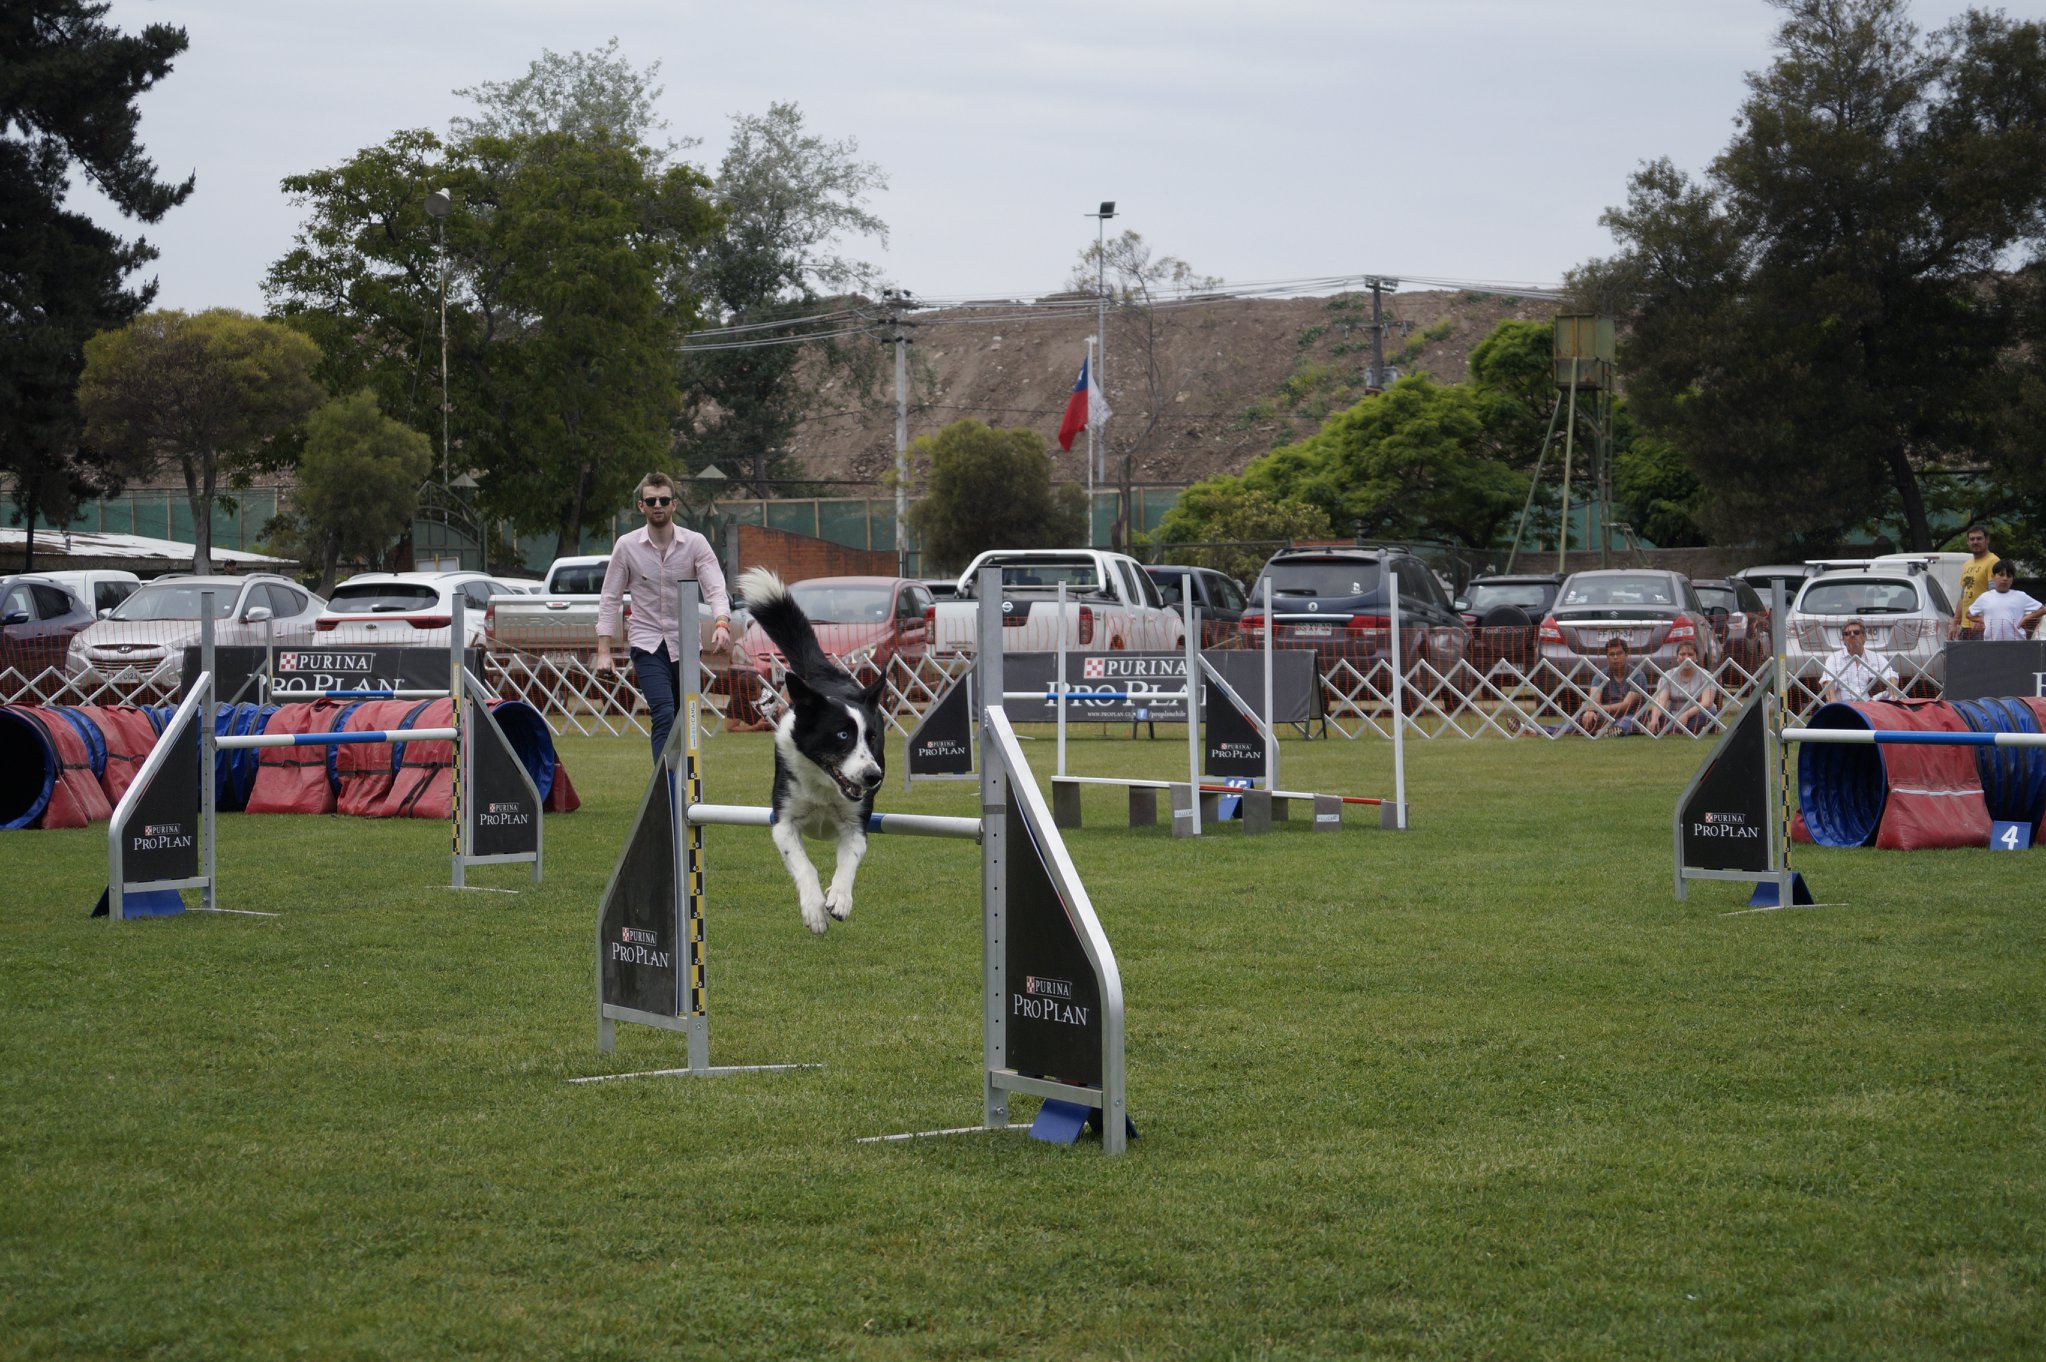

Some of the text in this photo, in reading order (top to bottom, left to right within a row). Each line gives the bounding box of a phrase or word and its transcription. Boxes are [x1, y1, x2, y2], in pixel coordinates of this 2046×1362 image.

[299, 656, 369, 670] PURINA
[1106, 660, 1187, 675] PURINA
[1045, 681, 1118, 707] PRO
[919, 747, 965, 757] PRO PLAN
[1211, 749, 1261, 759] PRO PLAN
[494, 804, 518, 812] PURINA
[480, 813, 528, 825] PRO PLAN
[1713, 814, 1743, 822] PURINA
[152, 825, 179, 834] PURINA
[1694, 823, 1758, 838] PRO PLAN
[134, 836, 192, 851] PRO PLAN
[2001, 825, 2019, 850] 4
[629, 930, 655, 944] PURINA
[612, 942, 669, 968] PRO PLAN
[1035, 980, 1070, 997] PURINA
[1013, 993, 1087, 1026] PRO PLAN
